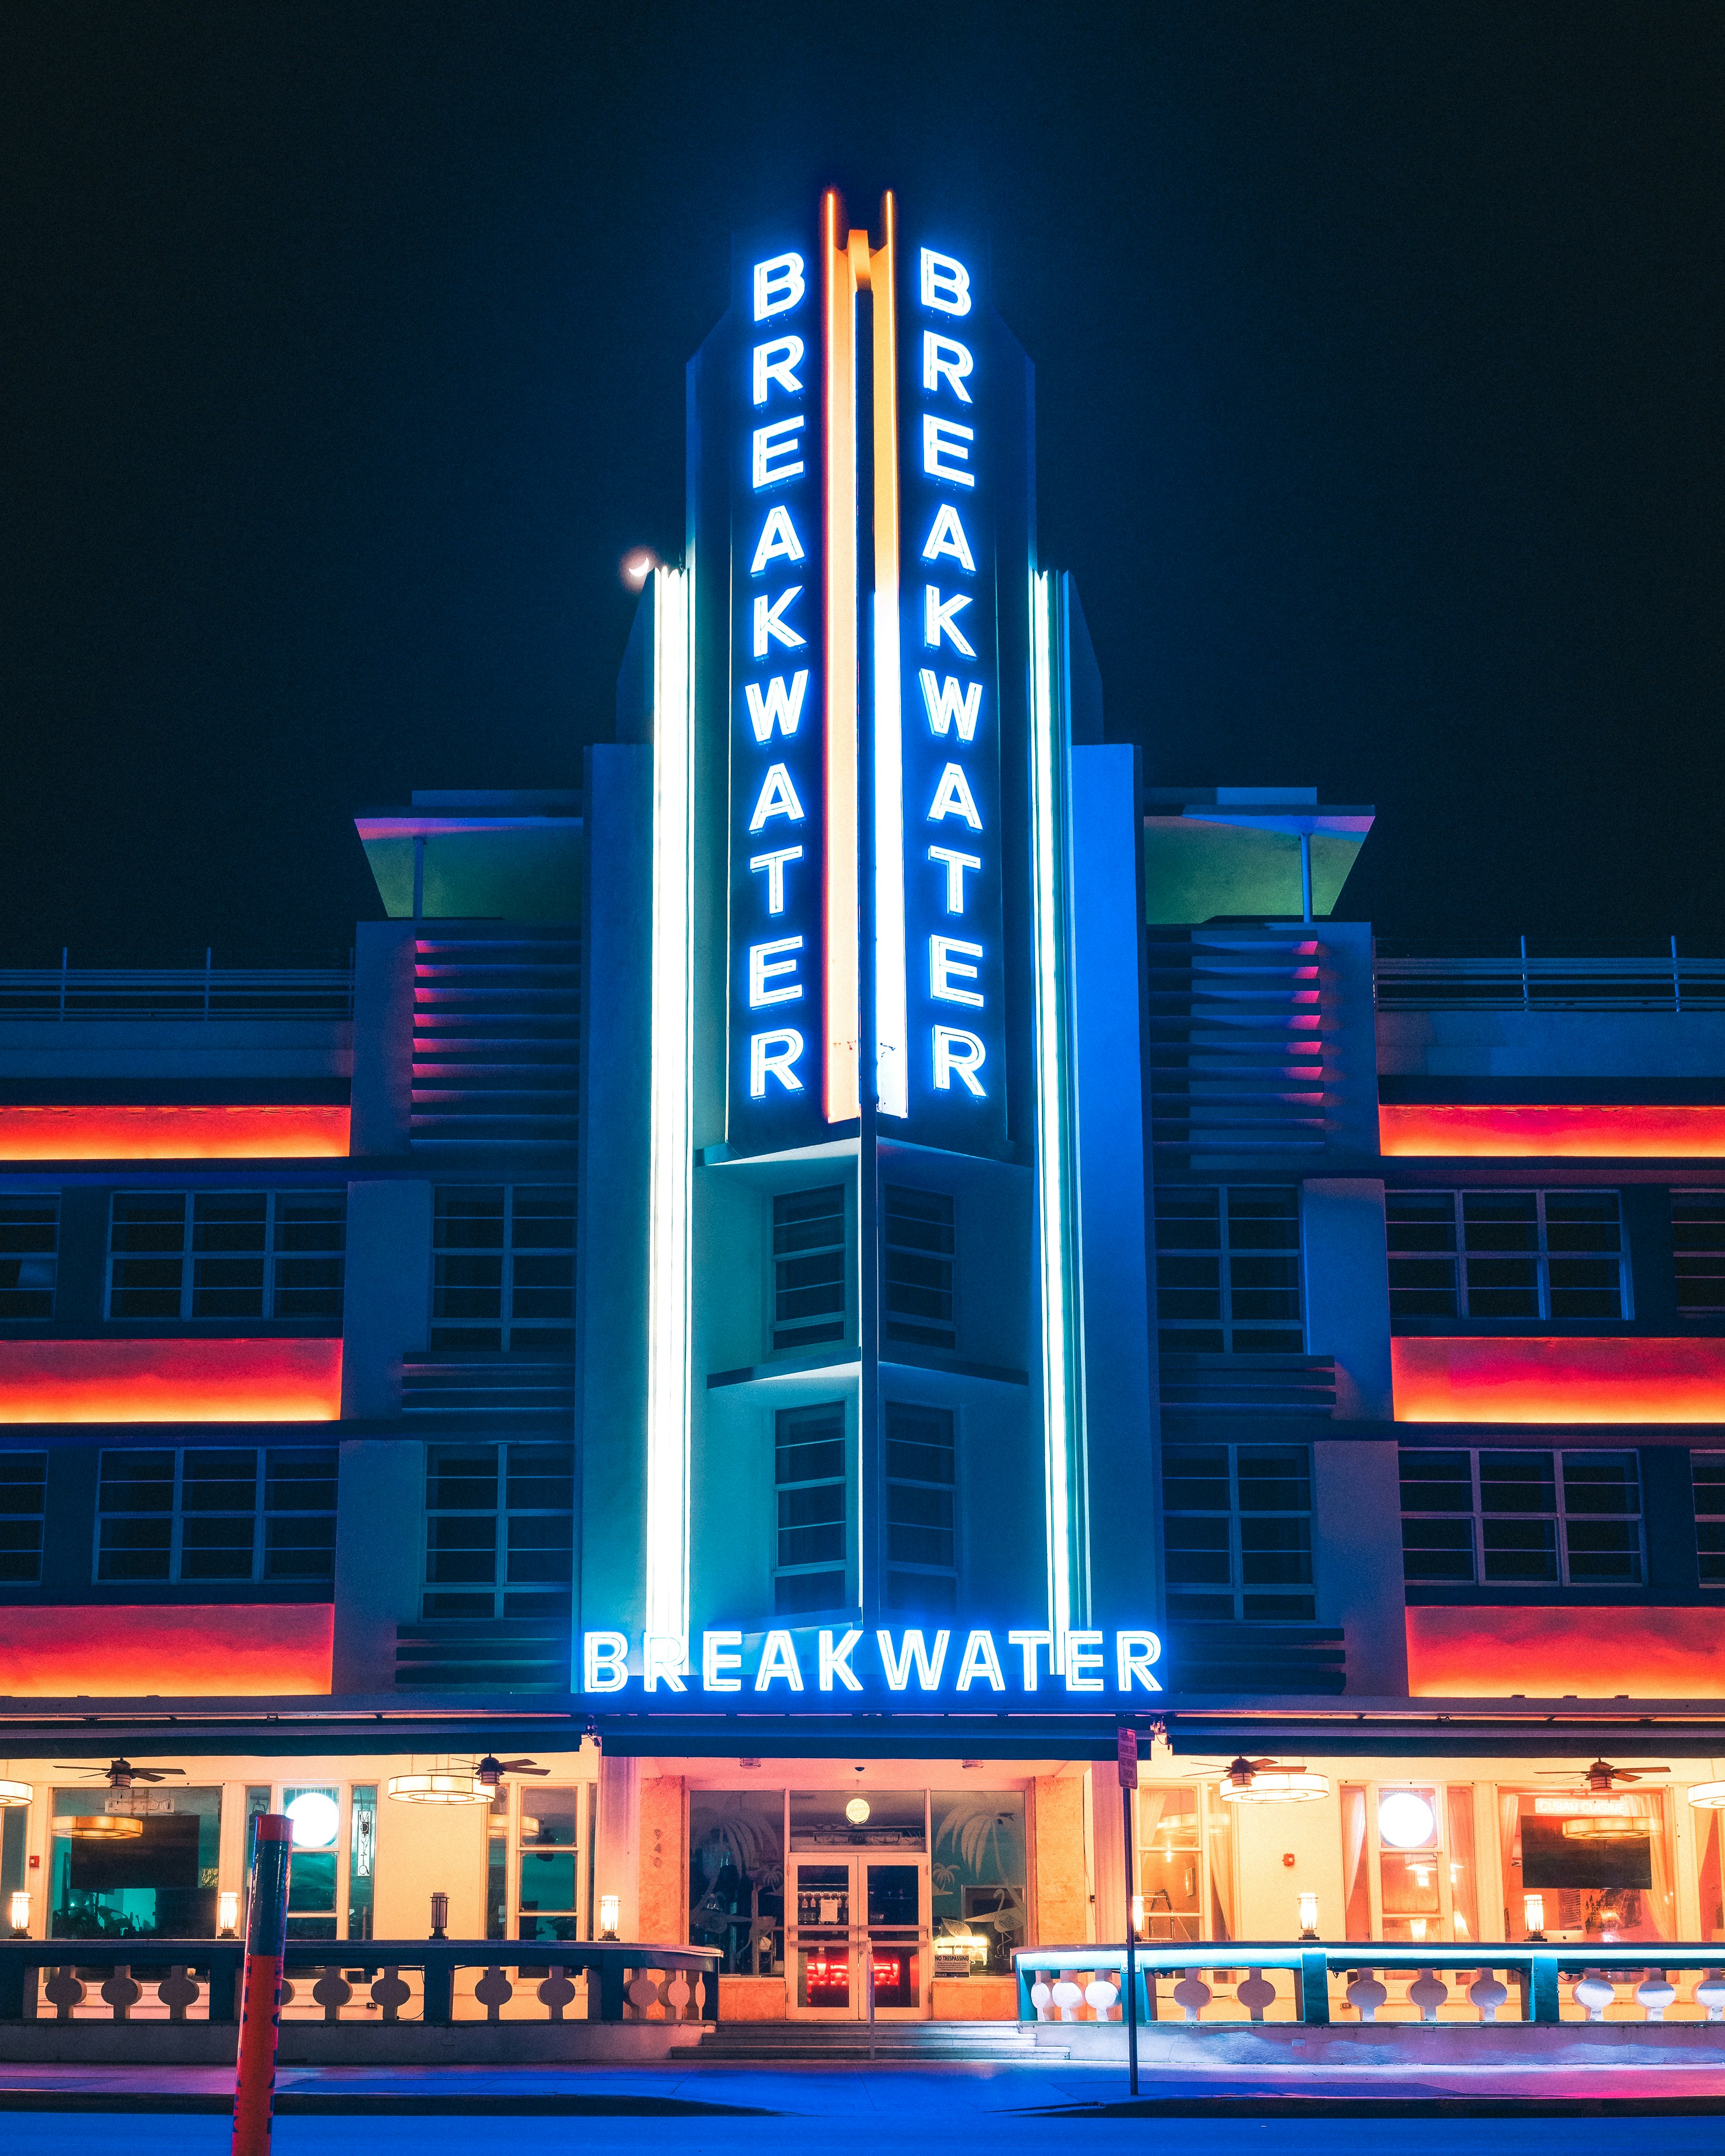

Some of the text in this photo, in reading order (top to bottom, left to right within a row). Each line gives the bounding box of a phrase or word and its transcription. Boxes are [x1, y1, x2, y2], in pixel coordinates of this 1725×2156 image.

[745, 252, 811, 1099] BREAKWATER
[919, 247, 987, 1098] BREAKWATER
[582, 1629, 1163, 1693] BREAKWATER
[1539, 1801, 1626, 1813] CUBAN CUISINE
[653, 1829, 662, 1868] 940
